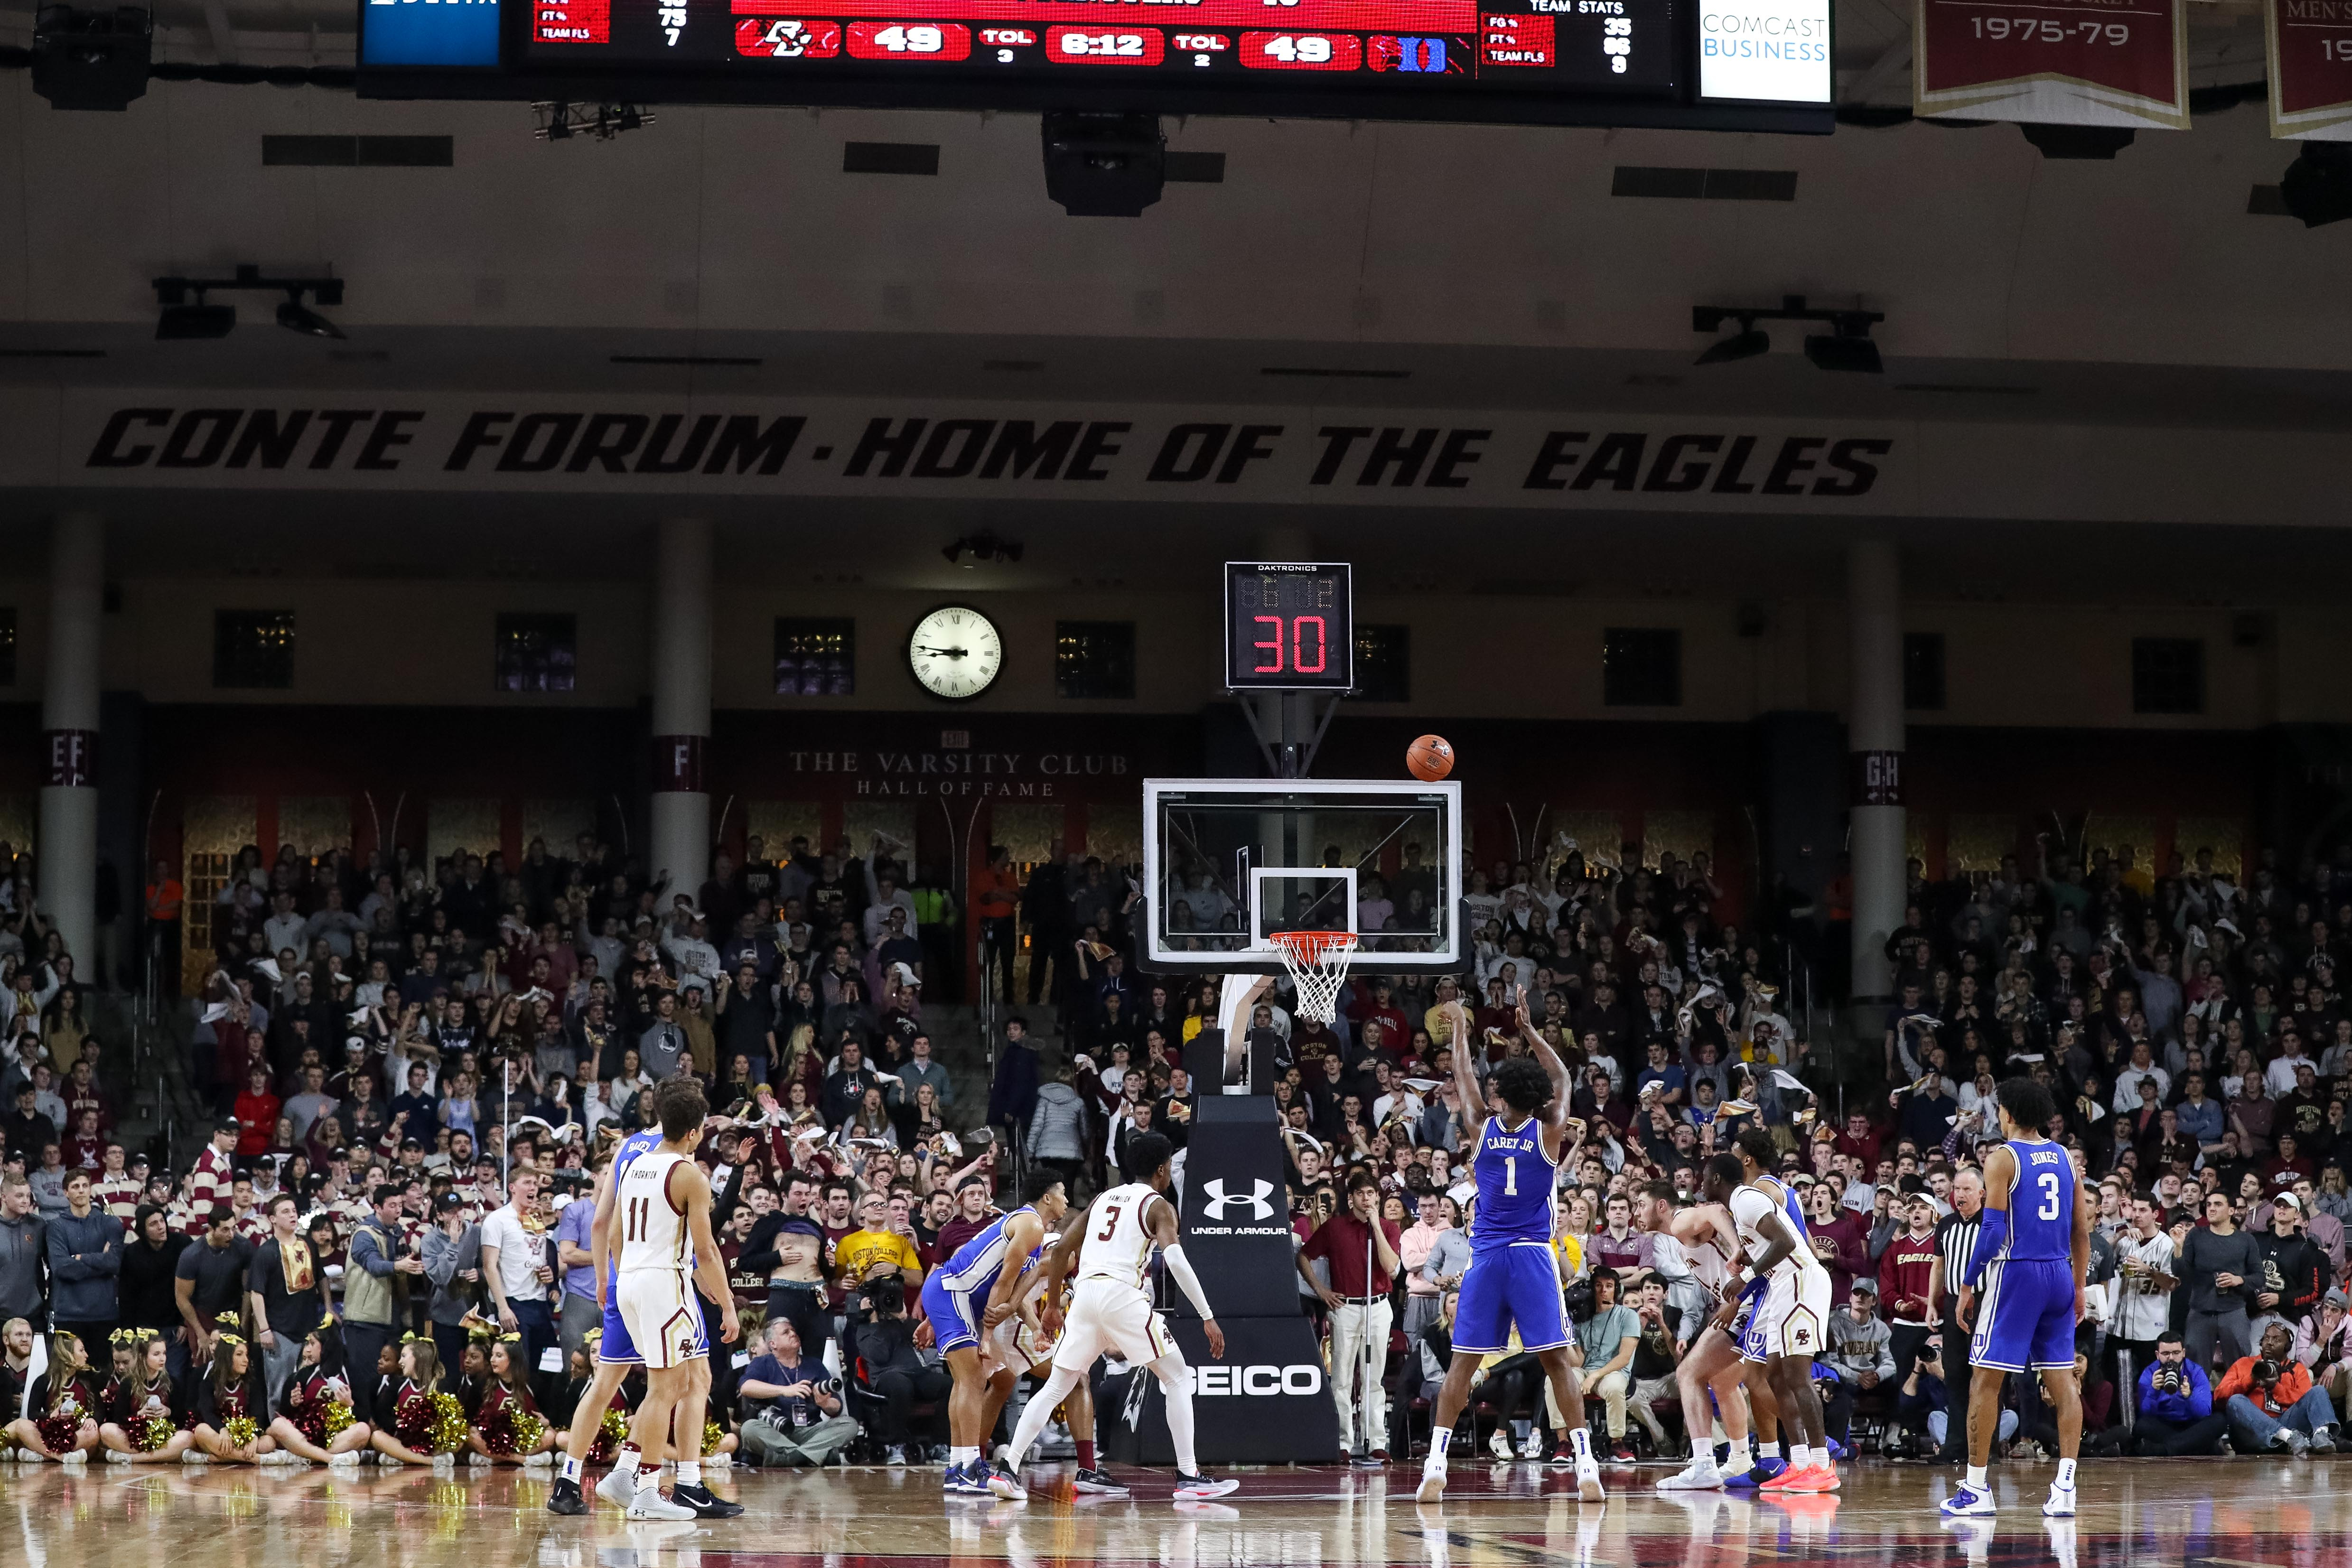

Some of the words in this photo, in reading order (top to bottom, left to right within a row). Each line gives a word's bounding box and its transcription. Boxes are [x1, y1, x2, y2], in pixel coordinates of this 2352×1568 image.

[1530, 0, 1570, 12] TEAM
[1578, 0, 1624, 14] STATS
[658, 9, 687, 26] 75
[1489, 17, 1506, 28] FG
[1703, 14, 1825, 37] COMCAST
[542, 28, 570, 38] TEAM
[572, 28, 590, 38] FLS
[1604, 18, 1632, 36] 35
[1971, 17, 2129, 46] 1975-79
[665, 28, 680, 46] 7
[874, 26, 941, 52] 49
[983, 30, 1033, 44] TOL
[1061, 33, 1143, 56] 6:12
[1175, 35, 1225, 50] TOL
[1490, 34, 1504, 44] FT
[997, 50, 1013, 63] 3
[1264, 36, 1333, 62] 49
[1490, 50, 1522, 61] TEAM
[1524, 51, 1545, 62] FLS
[1704, 38, 1825, 61] BUSINESS
[1194, 54, 1210, 66] 2
[86, 408, 426, 470] CONTE
[443, 411, 807, 475] FORUM
[843, 418, 1133, 481] HOME
[1147, 423, 1285, 483] OF
[1309, 427, 1493, 488] THE
[1522, 431, 1894, 497] EAGLES
[1254, 616, 1325, 672] 30
[53, 736, 83, 767] EF
[675, 745, 688, 776] F
[790, 752, 858, 772] THE
[878, 753, 1020, 775] VARSITY
[1040, 755, 1127, 775] CLUB
[1867, 756, 1898, 786] GH
[858, 781, 927, 795] HALL
[940, 782, 971, 795] OF
[984, 783, 1053, 797] FAME
[1470, 904, 1495, 914] OSTON
[2296, 1105, 2322, 1115] BOSTON
[1487, 1137, 1519, 1150] CAREY
[1519, 1139, 1534, 1153] JR
[2029, 1152, 2059, 1166] JONES
[631, 1169, 657, 1179] THORNTON
[1504, 1157, 1518, 1196] 1
[2037, 1173, 2060, 1221] 3
[628, 1197, 649, 1242] 11
[1098, 1206, 1120, 1241] 3
[853, 1247, 873, 1260] BOSTON
[731, 1278, 764, 1288] COLLEGE
